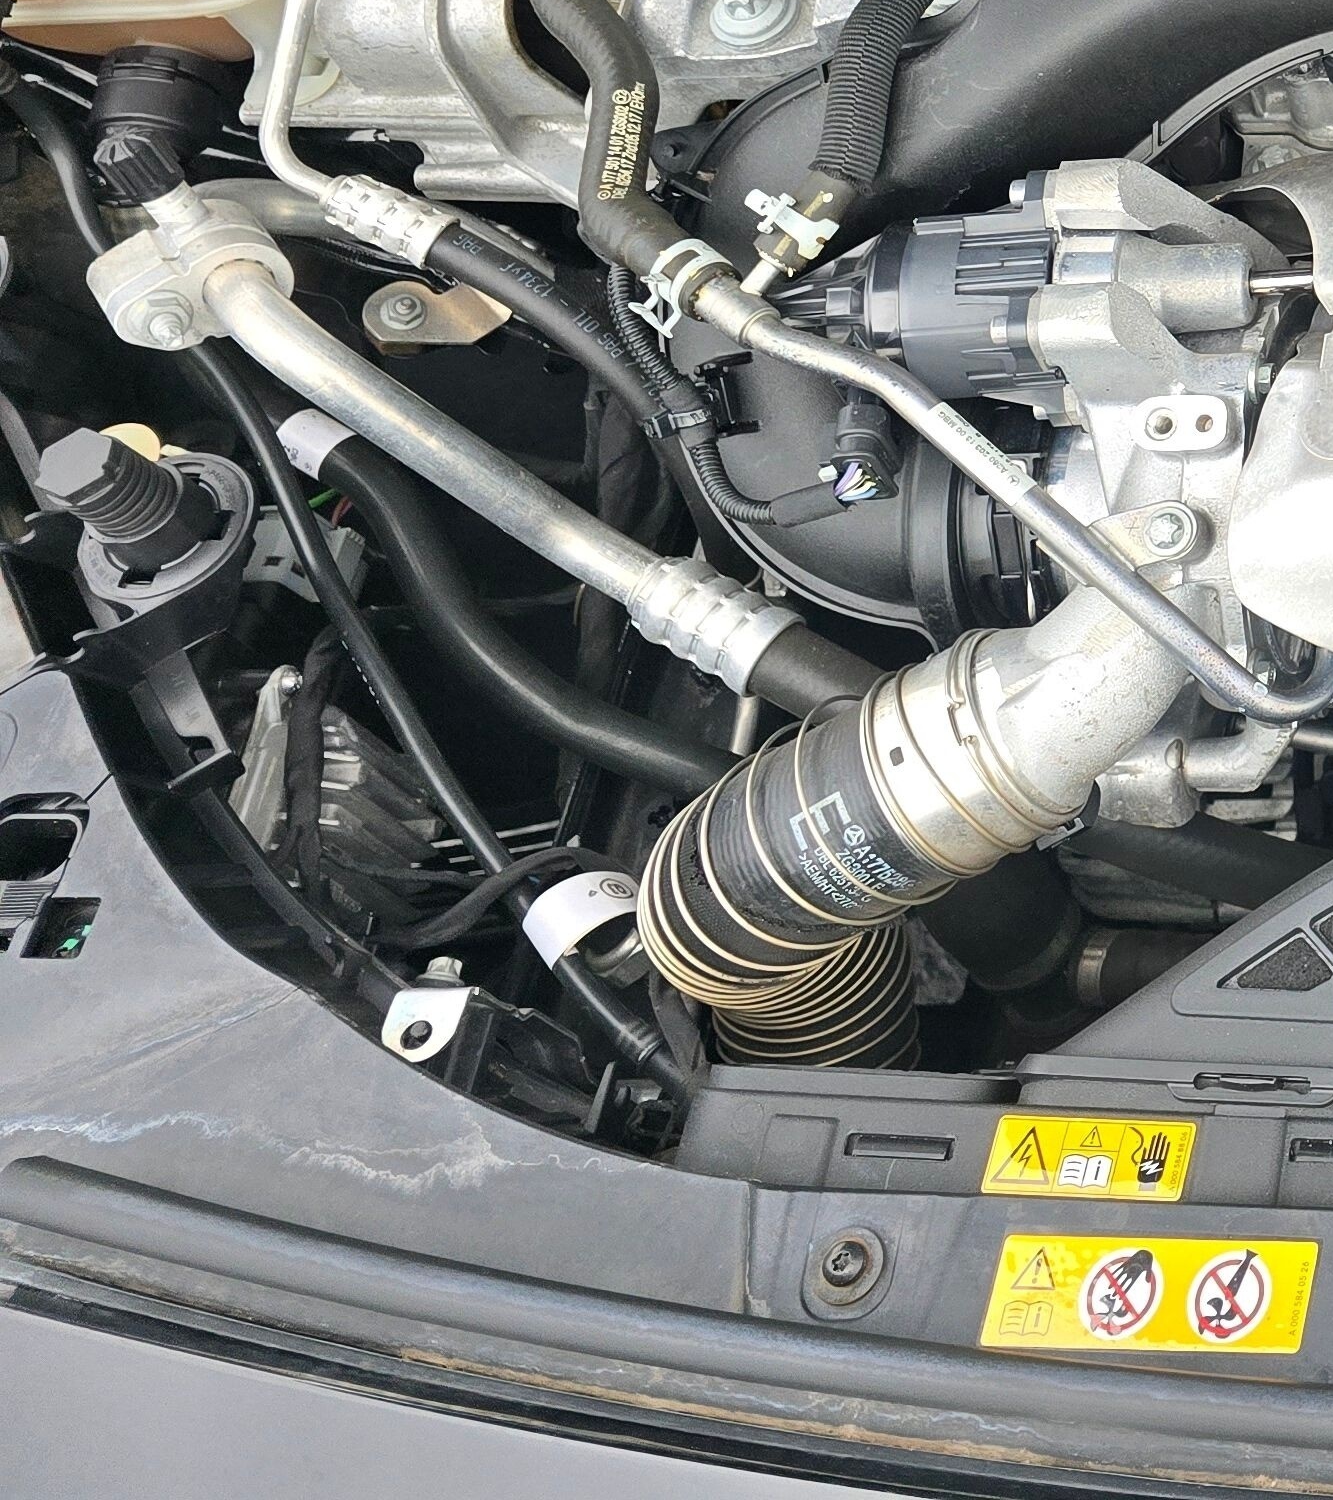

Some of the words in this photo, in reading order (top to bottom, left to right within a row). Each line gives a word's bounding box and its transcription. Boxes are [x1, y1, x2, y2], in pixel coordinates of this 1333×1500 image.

[1300, 1261, 1309, 1273] 26
[1298, 1275, 1307, 1287] 05
[1294, 1289, 1304, 1307] 584
[1290, 1309, 1300, 1327] 000
